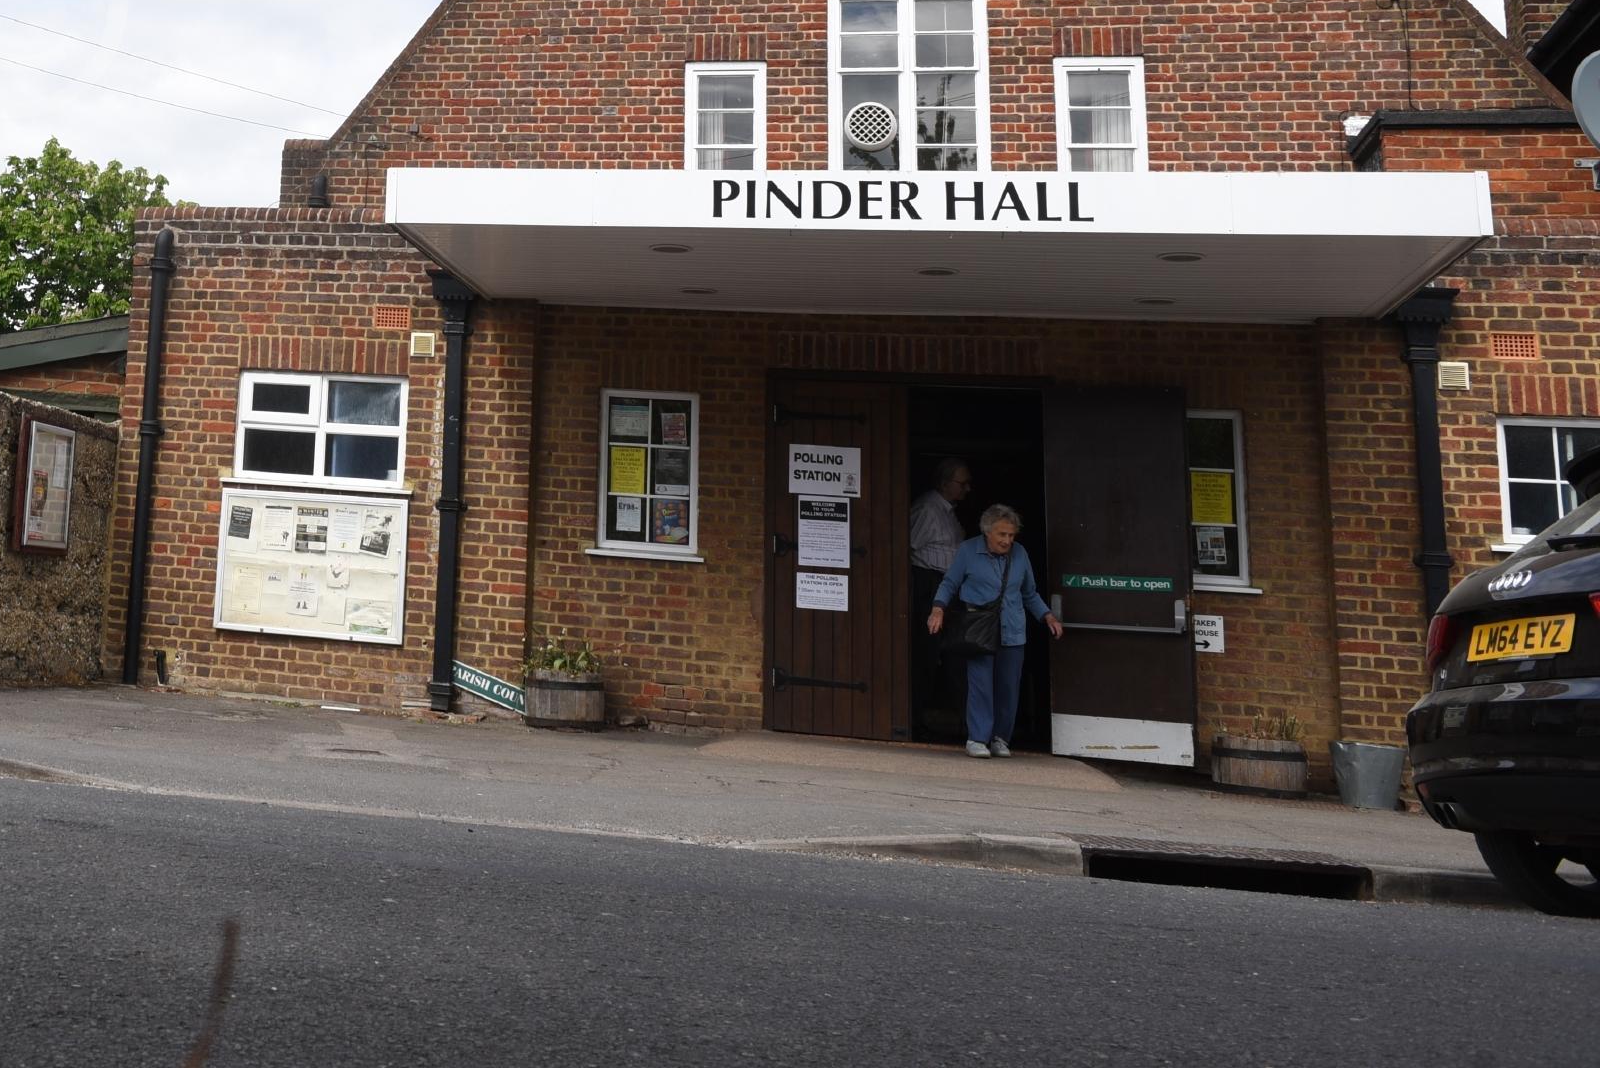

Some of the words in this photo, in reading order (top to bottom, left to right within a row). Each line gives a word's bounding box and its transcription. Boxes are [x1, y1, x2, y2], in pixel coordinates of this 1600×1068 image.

[712, 179, 922, 221] PINDER
[945, 181, 1095, 222] HALL
[793, 452, 843, 465] POLLING
[793, 469, 841, 482] STATION
[1081, 576, 1108, 587] Push
[1110, 577, 1127, 587] bar
[1130, 579, 1141, 588] to
[1143, 581, 1171, 591] open
[1475, 623, 1520, 655] LM64
[1523, 619, 1566, 649] EYZ
